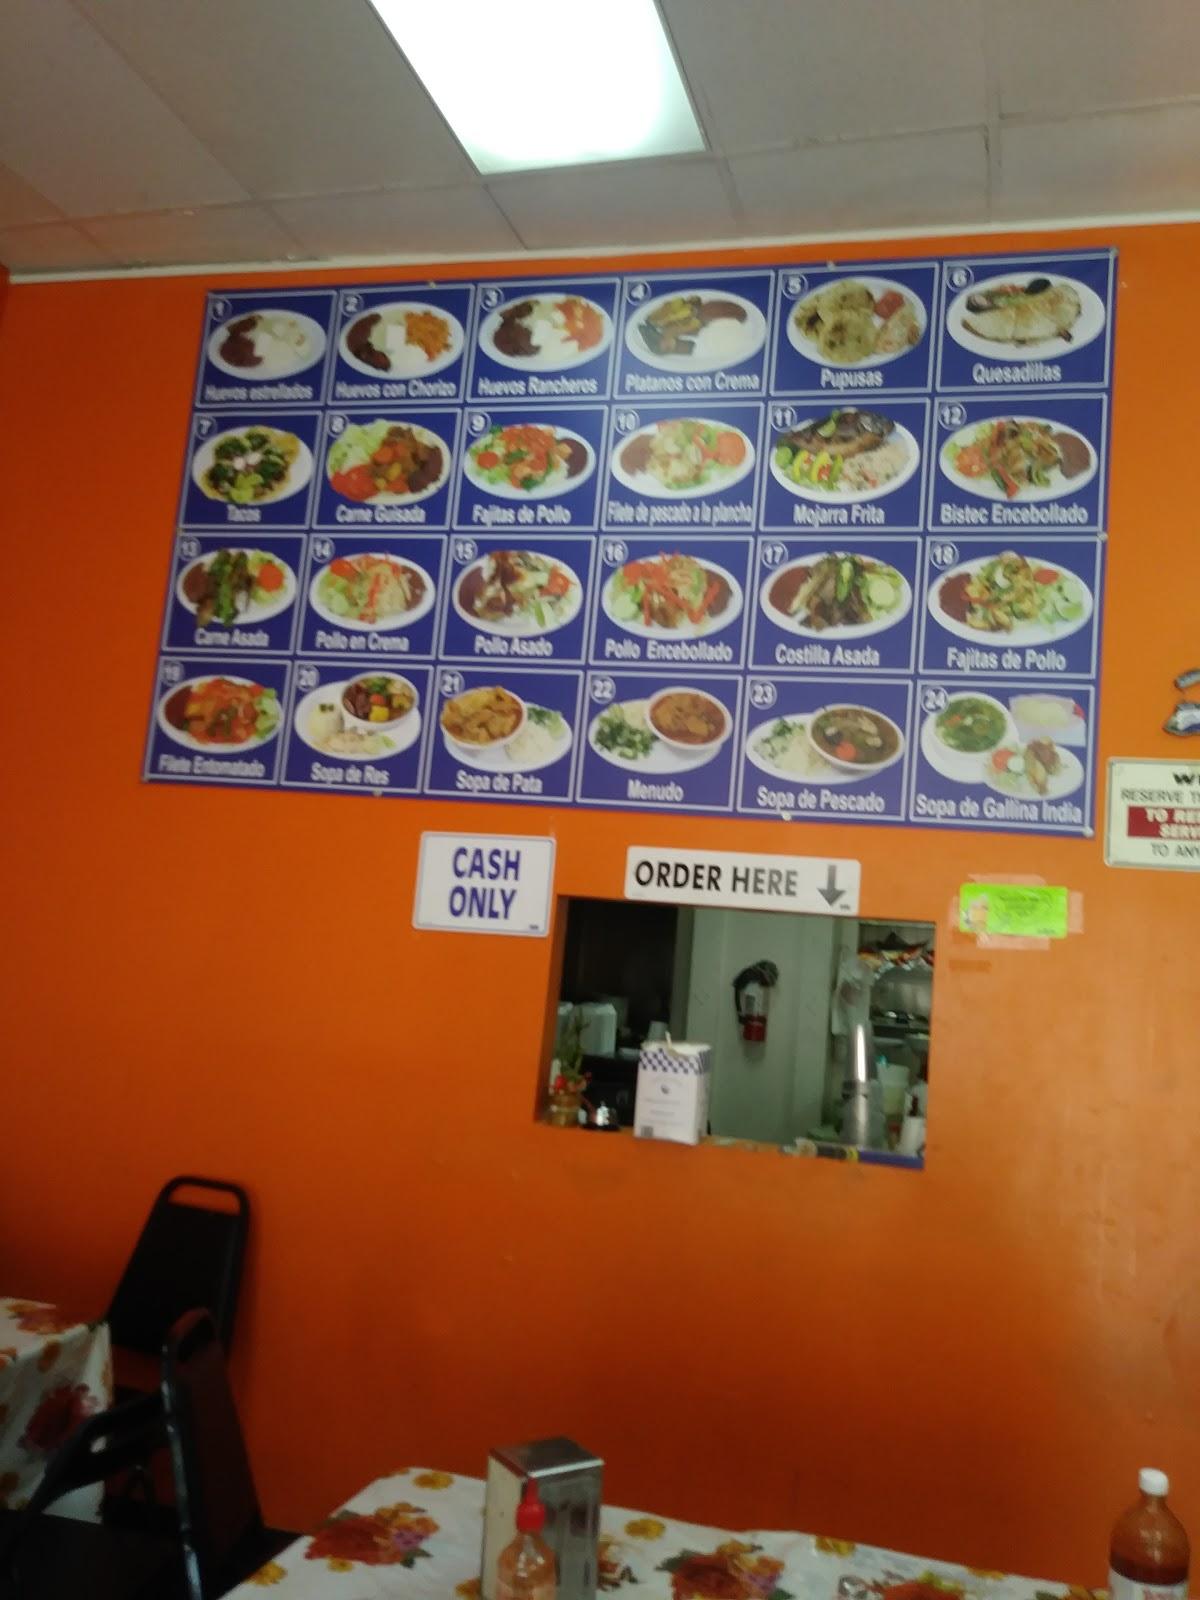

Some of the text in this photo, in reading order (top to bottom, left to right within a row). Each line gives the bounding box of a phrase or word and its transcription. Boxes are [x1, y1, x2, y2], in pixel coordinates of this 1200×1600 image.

[787, 277, 802, 293] 5
[953, 269, 968, 287] 6
[485, 289, 498, 306] 3
[631, 283, 645, 299] 4
[346, 297, 360, 312] 2
[625, 372, 760, 392] Platanos con Crema
[820, 368, 884, 391] Pupusas
[972, 361, 1062, 384] Quesadillas
[382, 384, 407, 398] con
[408, 379, 457, 397] Chorizo
[528, 375, 598, 395] Rancheros
[331, 417, 343, 432] 8
[471, 415, 485, 432] 9
[618, 413, 636, 431] 10
[773, 408, 794, 426] 11
[940, 406, 963, 424] 12
[227, 505, 262, 522] Tacos
[336, 504, 427, 523] Carne Guisada
[472, 505, 572, 528] Fajitas de Pollo
[636, 501, 649, 522] de
[793, 504, 885, 529] Mojarra Frita
[940, 503, 1089, 525] Bistec Encebollado
[314, 542, 332, 558] 14
[456, 542, 474, 559] 15
[604, 545, 625, 560] 16
[764, 545, 785, 564] 17
[933, 545, 954, 564] 18
[194, 627, 270, 647] Carne Asada
[315, 631, 410, 651] Pollo en Crema
[474, 635, 553, 657] Pollo Asado
[605, 638, 733, 662] Pollo Encebollado
[775, 643, 880, 667] Costilla Asada
[946, 646, 1067, 674] Fajitas de Pollo
[442, 675, 460, 693] 21
[591, 681, 613, 698] 22
[751, 684, 774, 703] 23
[925, 689, 948, 708] 24
[310, 762, 390, 786] Sopa de Res
[456, 769, 543, 794] Sopa de Pata
[627, 779, 684, 802] Menudo
[756, 785, 885, 813] Sopa de Pescado
[1121, 788, 1183, 803] RESERVE
[915, 794, 1083, 825] Sopa de Gallina India
[1144, 807, 1169, 823] TO
[1151, 842, 1170, 858] TO
[452, 846, 521, 882] CASH
[634, 859, 799, 898] ORDER HERE
[448, 885, 518, 920] ONLY
